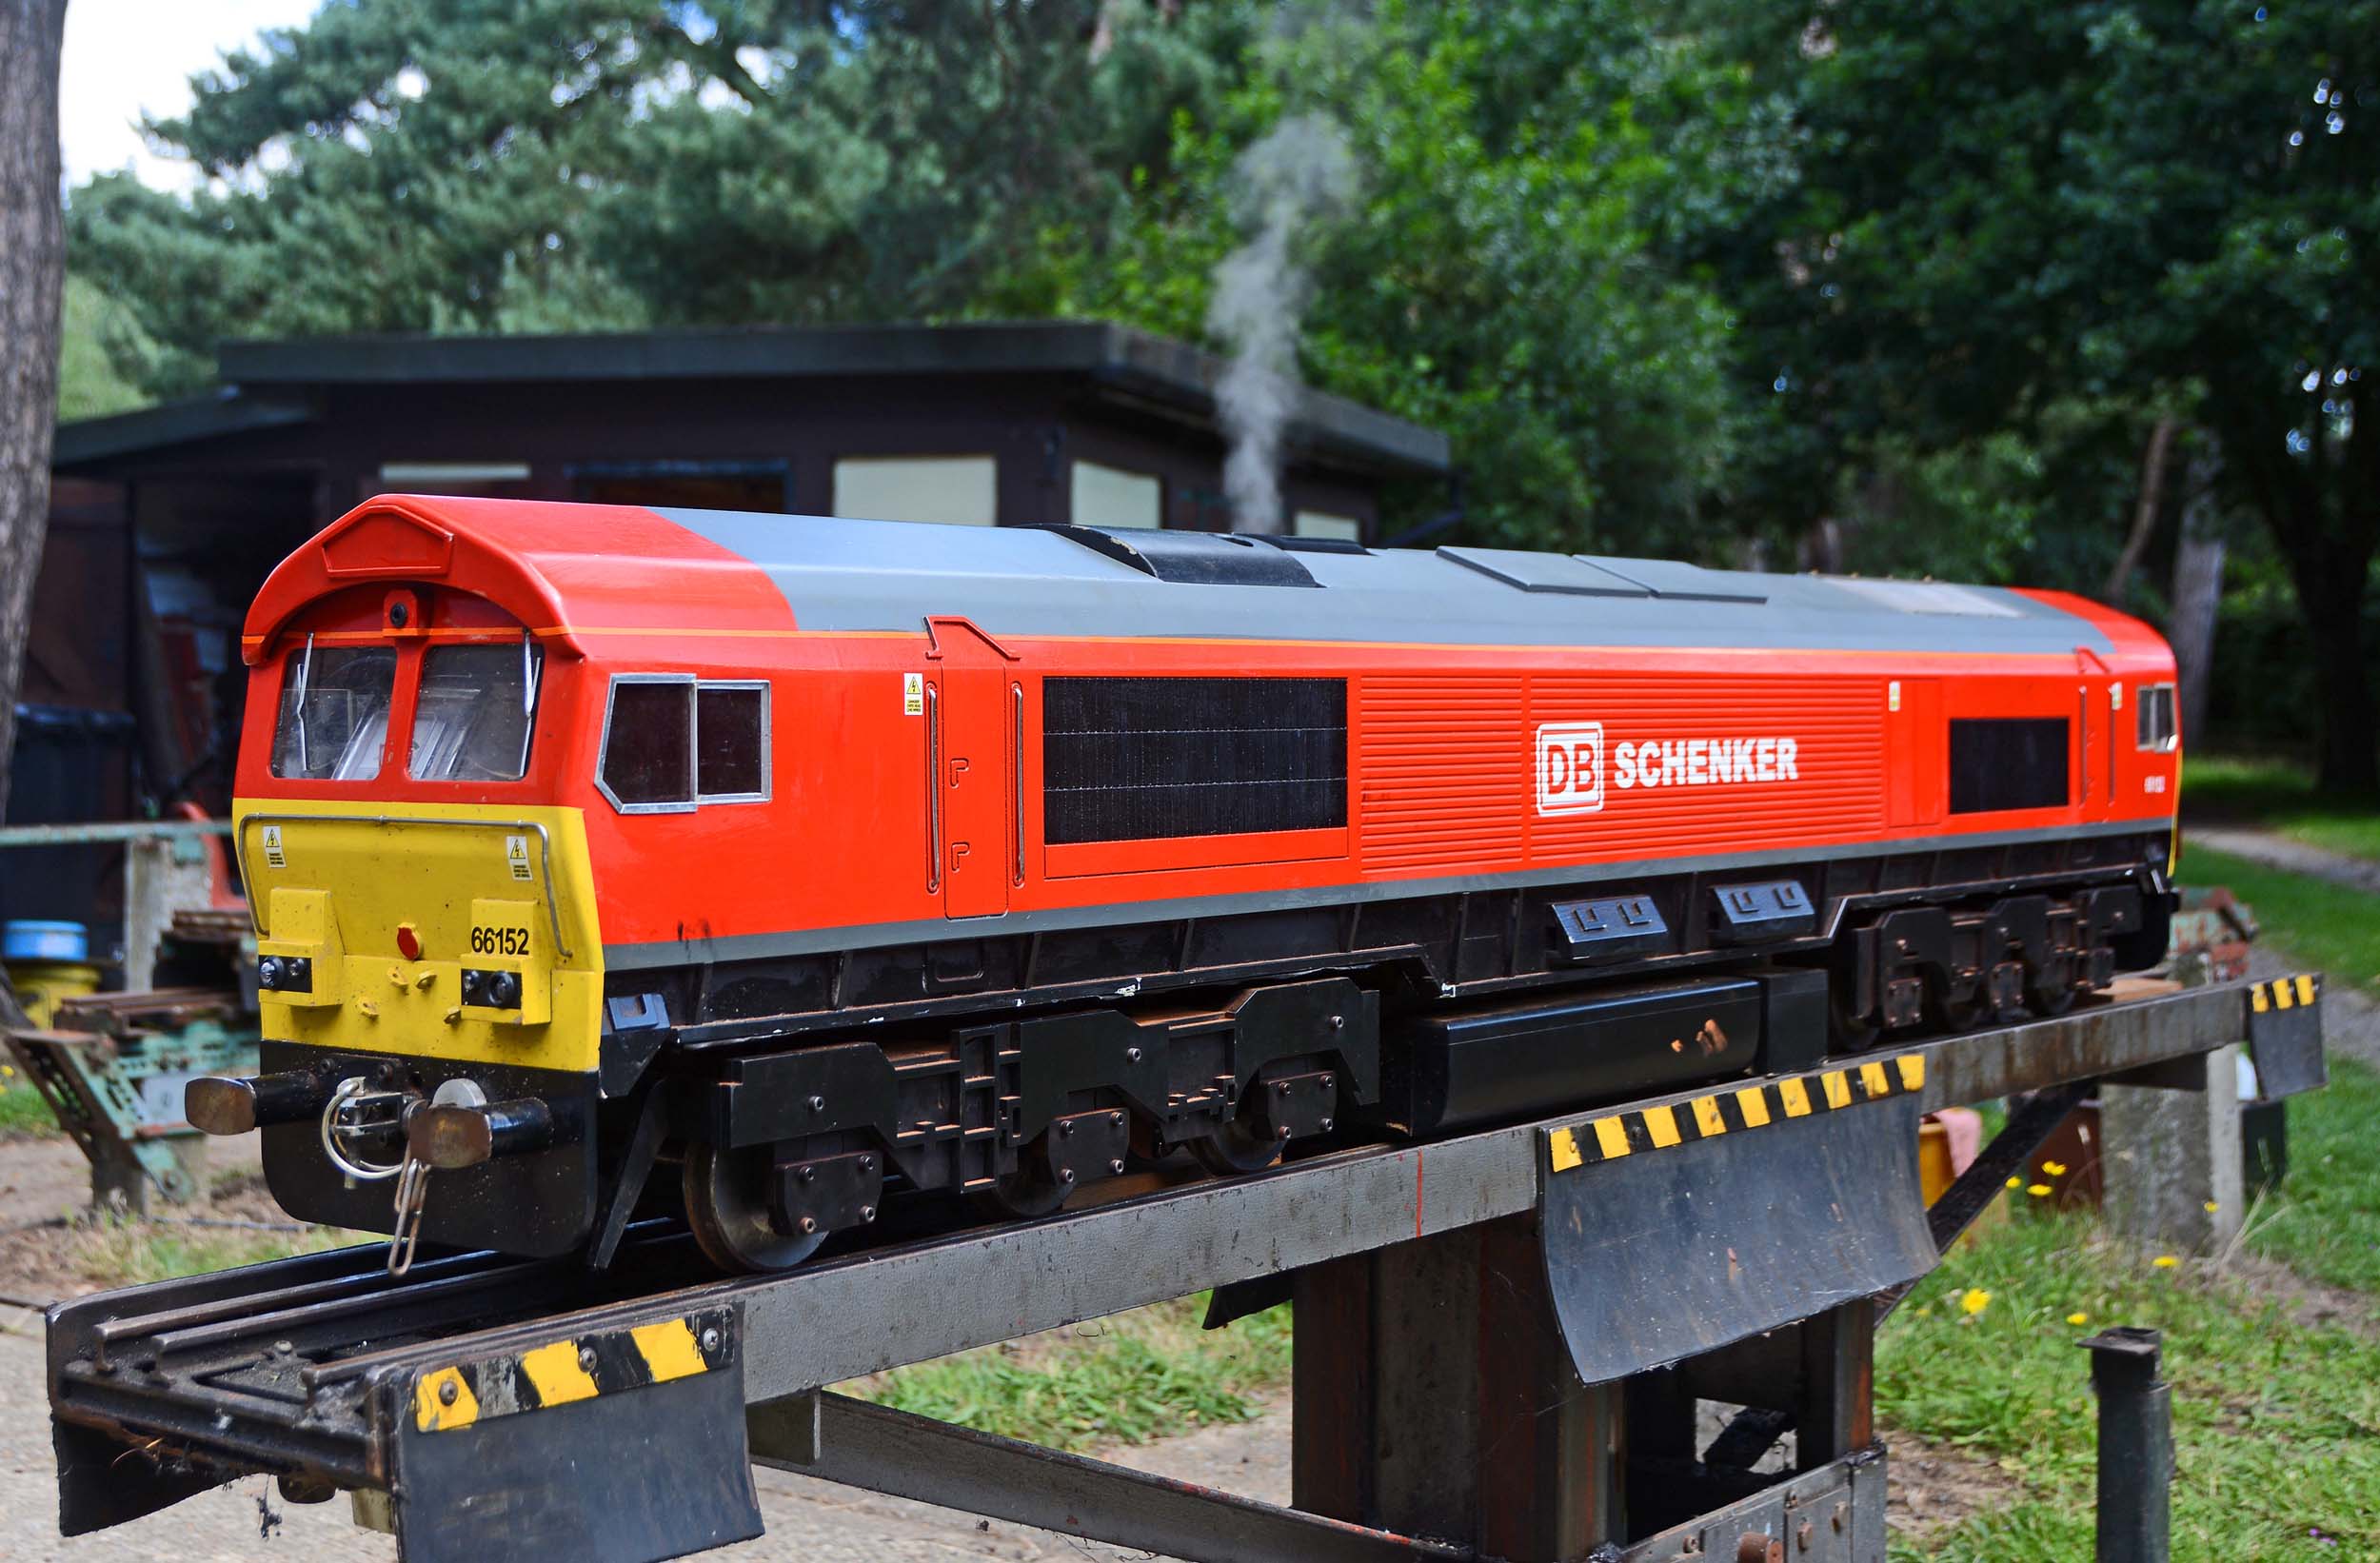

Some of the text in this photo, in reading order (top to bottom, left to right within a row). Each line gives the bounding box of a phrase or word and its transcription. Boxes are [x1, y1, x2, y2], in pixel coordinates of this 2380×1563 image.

[1545, 738, 1798, 796] DB SCHENKER
[471, 926, 529, 956] 66152
